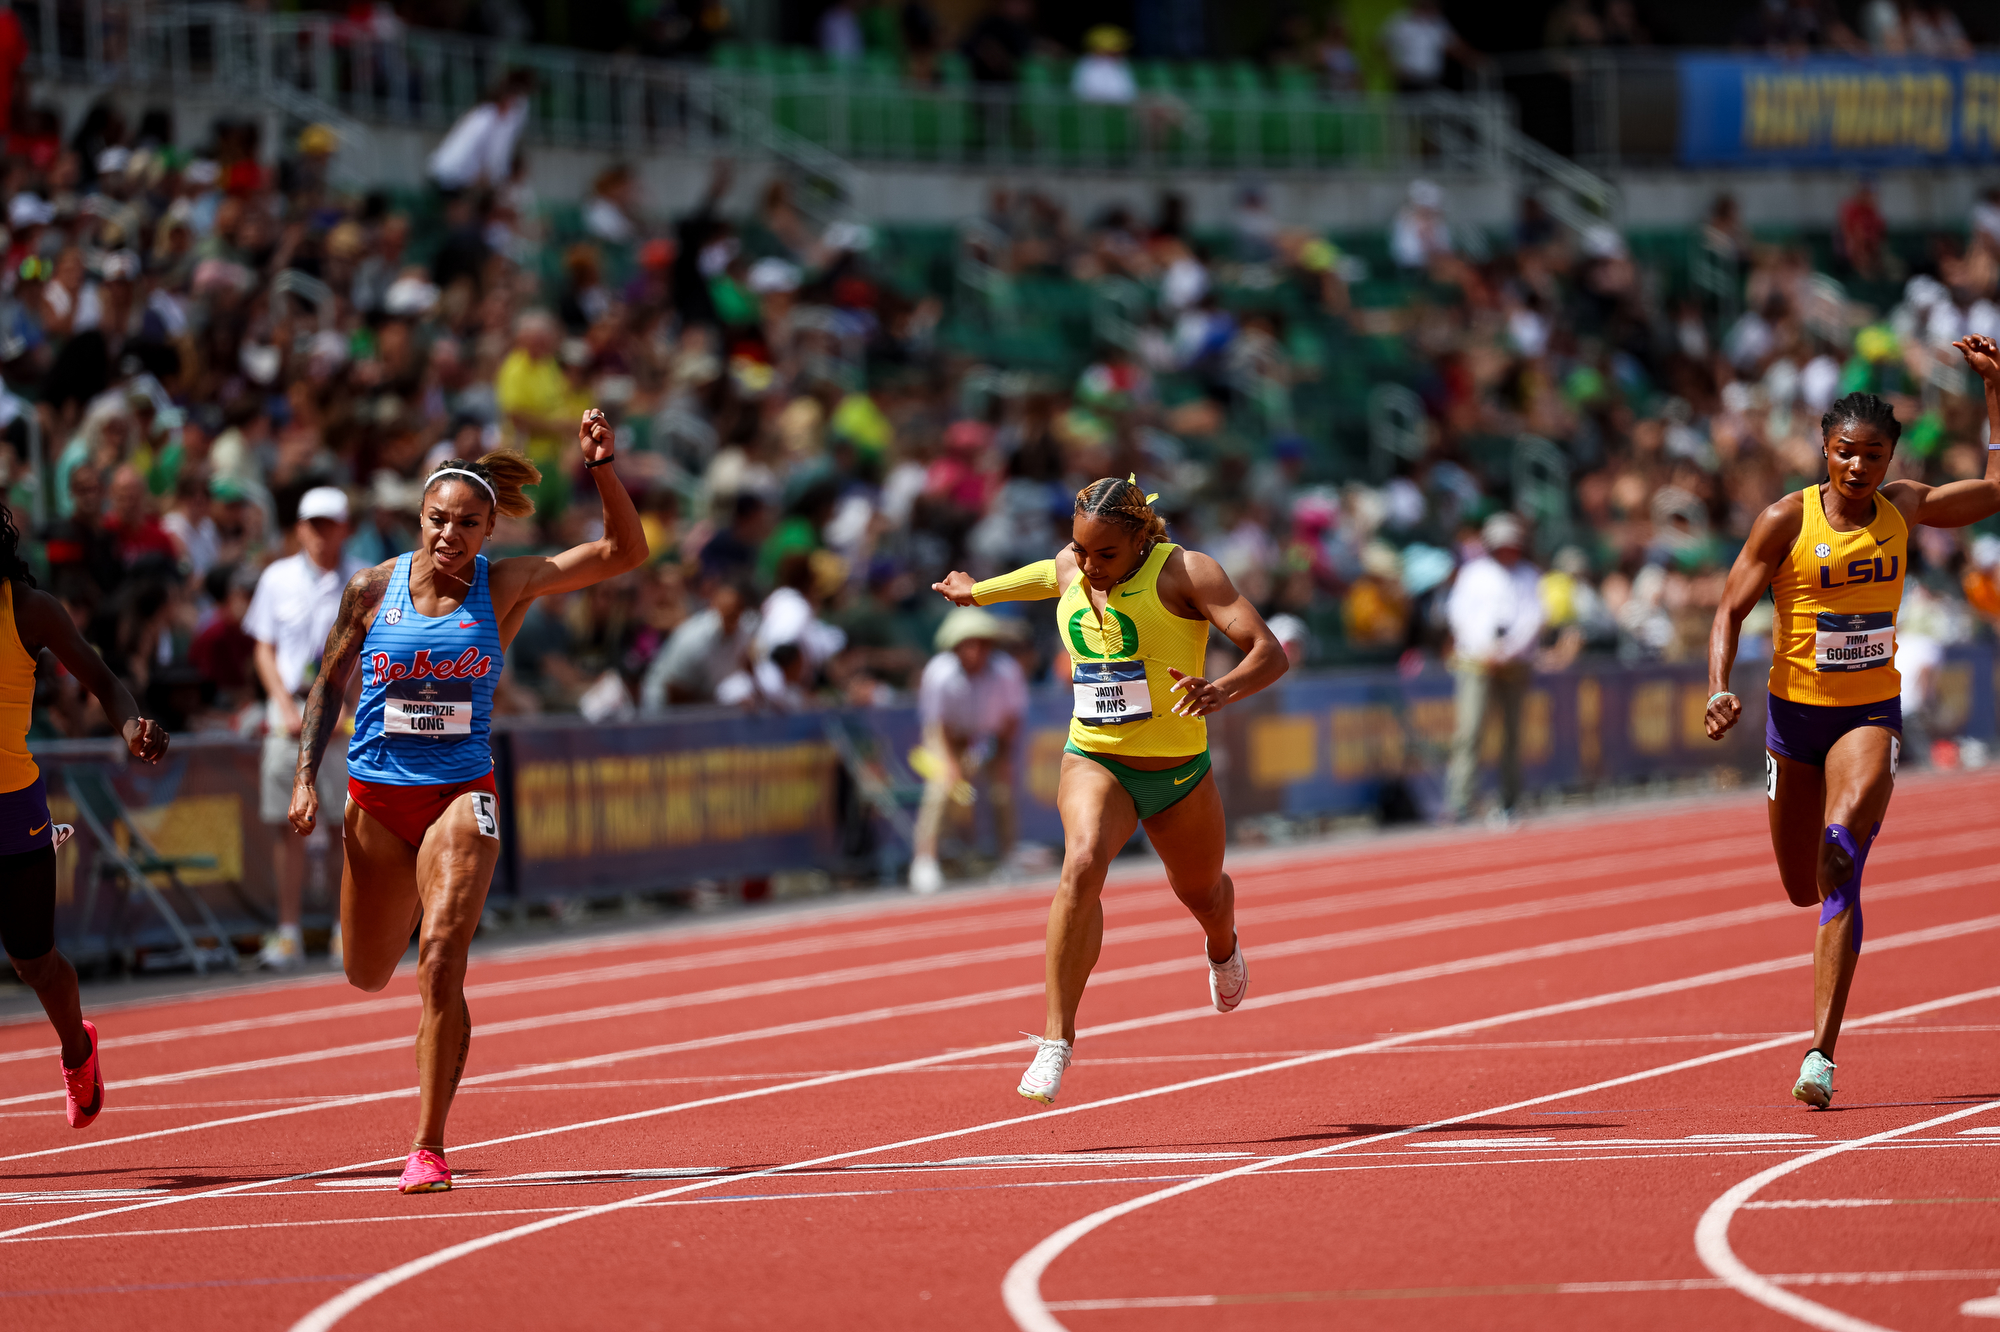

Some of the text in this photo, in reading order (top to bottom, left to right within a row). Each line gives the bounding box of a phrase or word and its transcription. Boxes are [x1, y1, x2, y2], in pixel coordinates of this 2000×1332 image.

[1815, 544, 1830, 557] SEC
[1820, 556, 1898, 588] LSU
[386, 608, 402, 625] SEC
[1846, 634, 1868, 645] TIMA
[1827, 643, 1884, 660] GODBLESS
[372, 646, 491, 686] Rebels
[1095, 686, 1123, 697] JADYN
[402, 704, 455, 716] MCKENZIE
[1096, 699, 1127, 713] MAYS
[411, 717, 445, 731] LONG
[480, 795, 496, 835] 5
